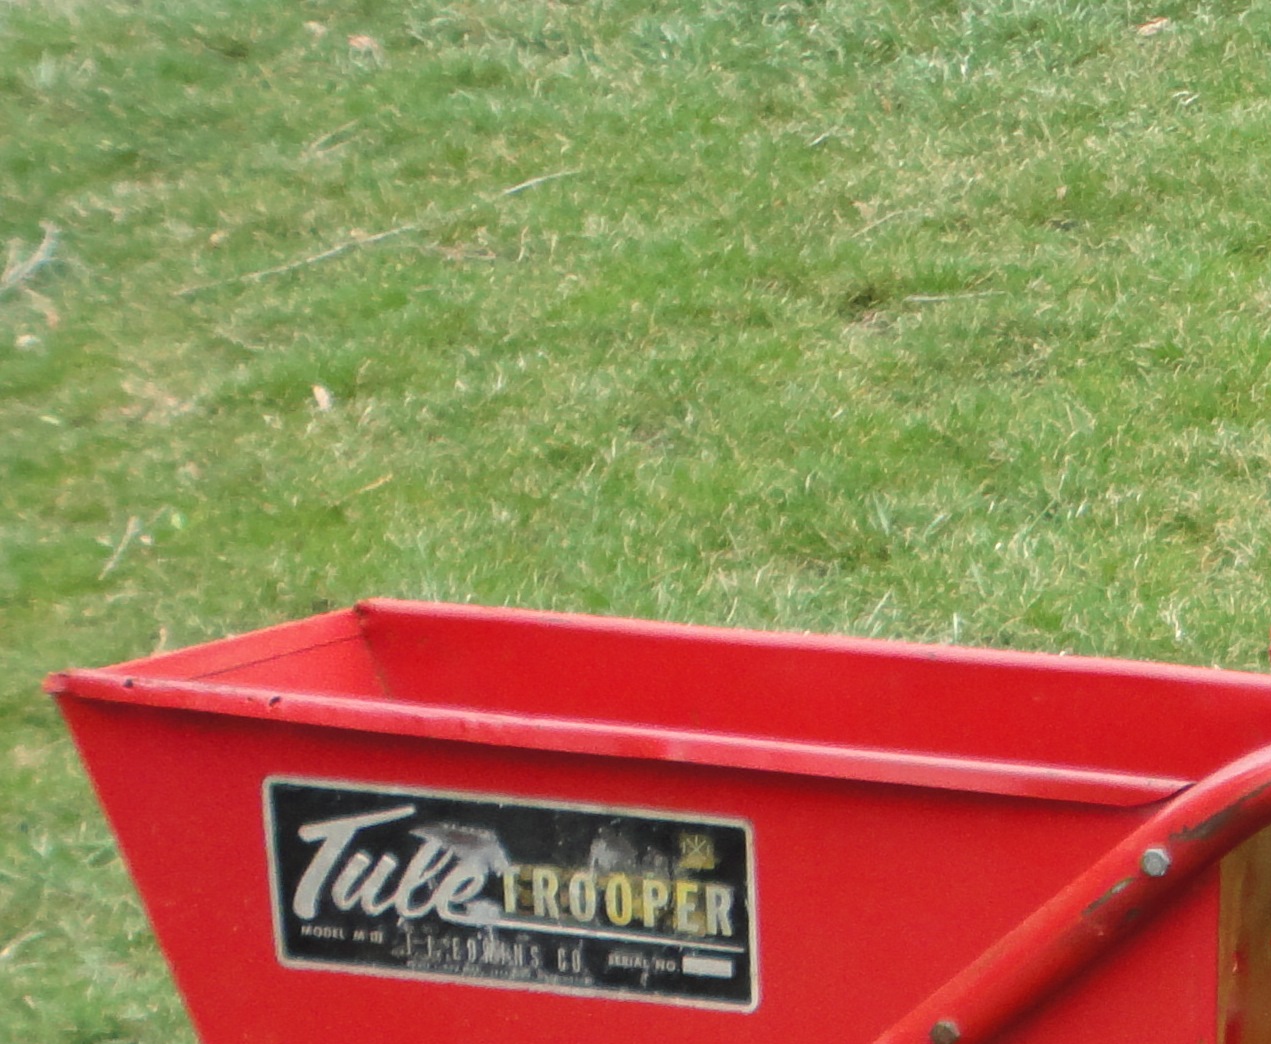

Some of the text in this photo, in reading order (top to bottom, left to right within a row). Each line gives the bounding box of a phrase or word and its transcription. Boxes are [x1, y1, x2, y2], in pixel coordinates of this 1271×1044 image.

[293, 805, 492, 923] Tule
[501, 863, 734, 938] TROOPER
[301, 925, 345, 940] MODEL
[608, 951, 649, 968] SERIAL
